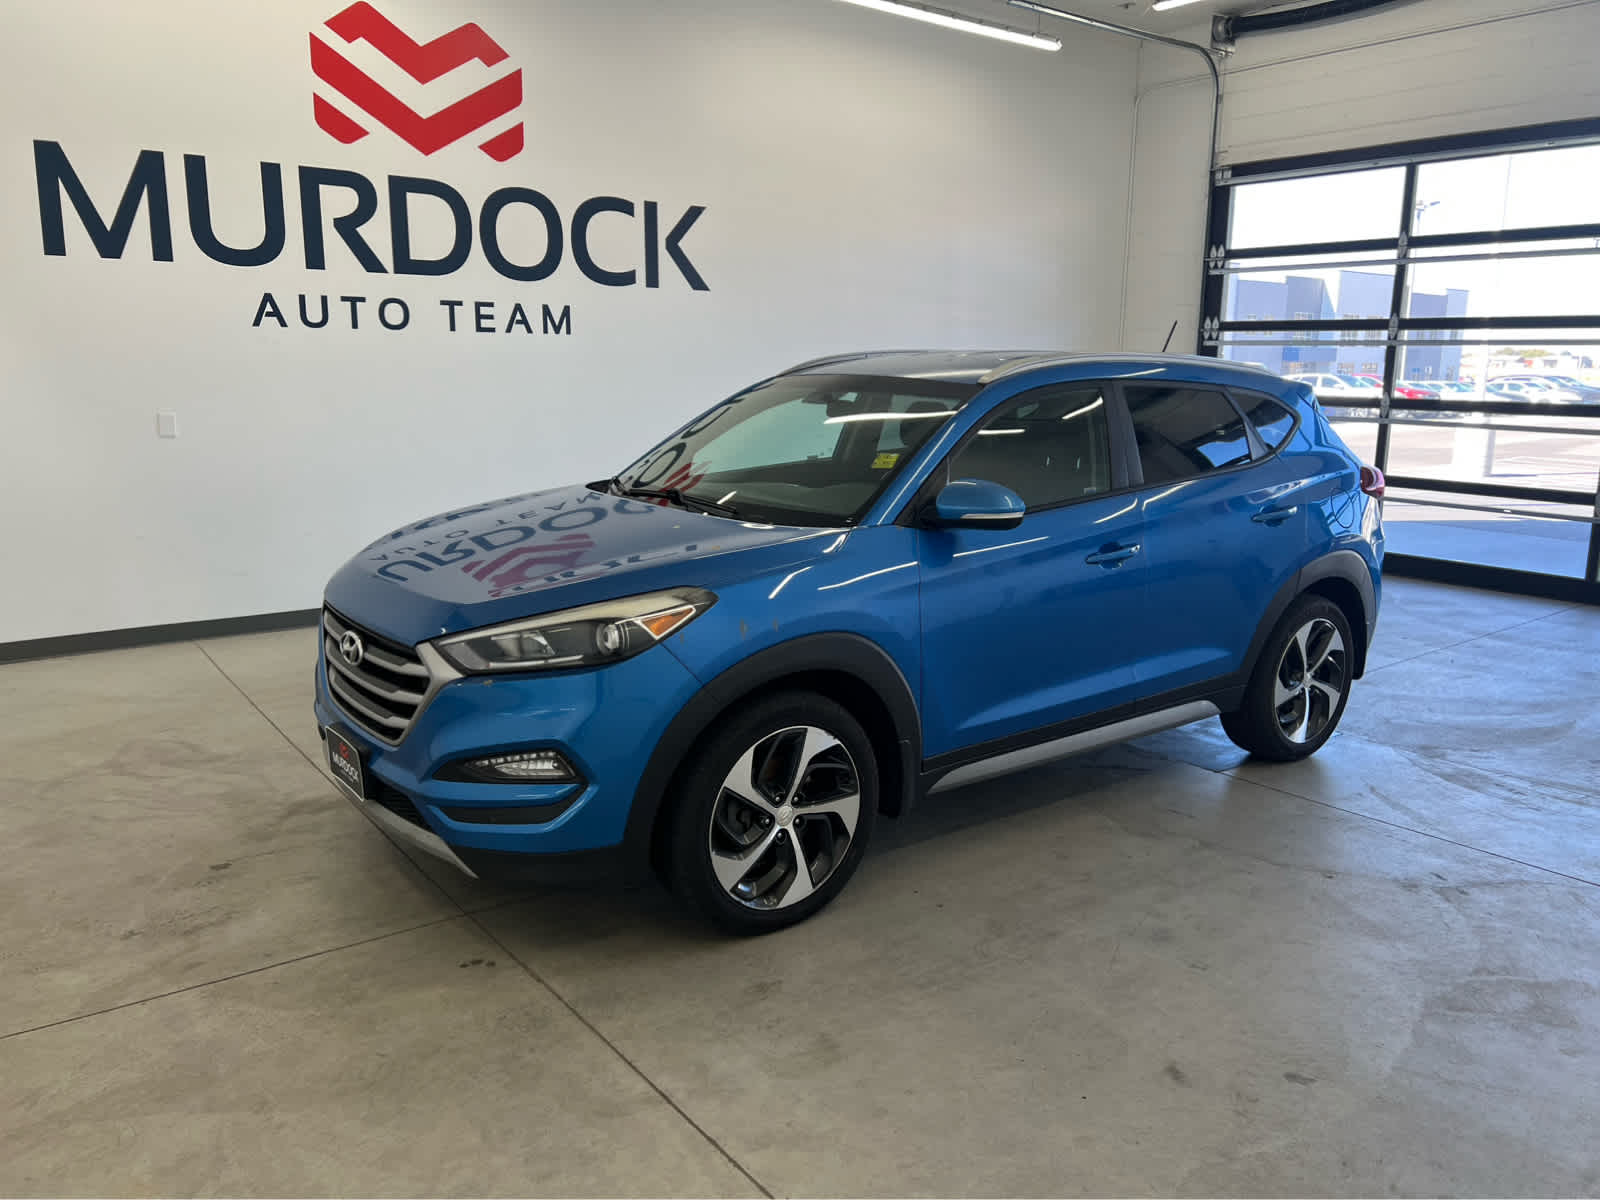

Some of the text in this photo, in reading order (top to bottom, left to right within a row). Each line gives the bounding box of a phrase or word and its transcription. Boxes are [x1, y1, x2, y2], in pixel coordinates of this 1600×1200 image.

[33, 139, 710, 292] MURDOCK
[252, 292, 572, 335] AUTO TEAM
